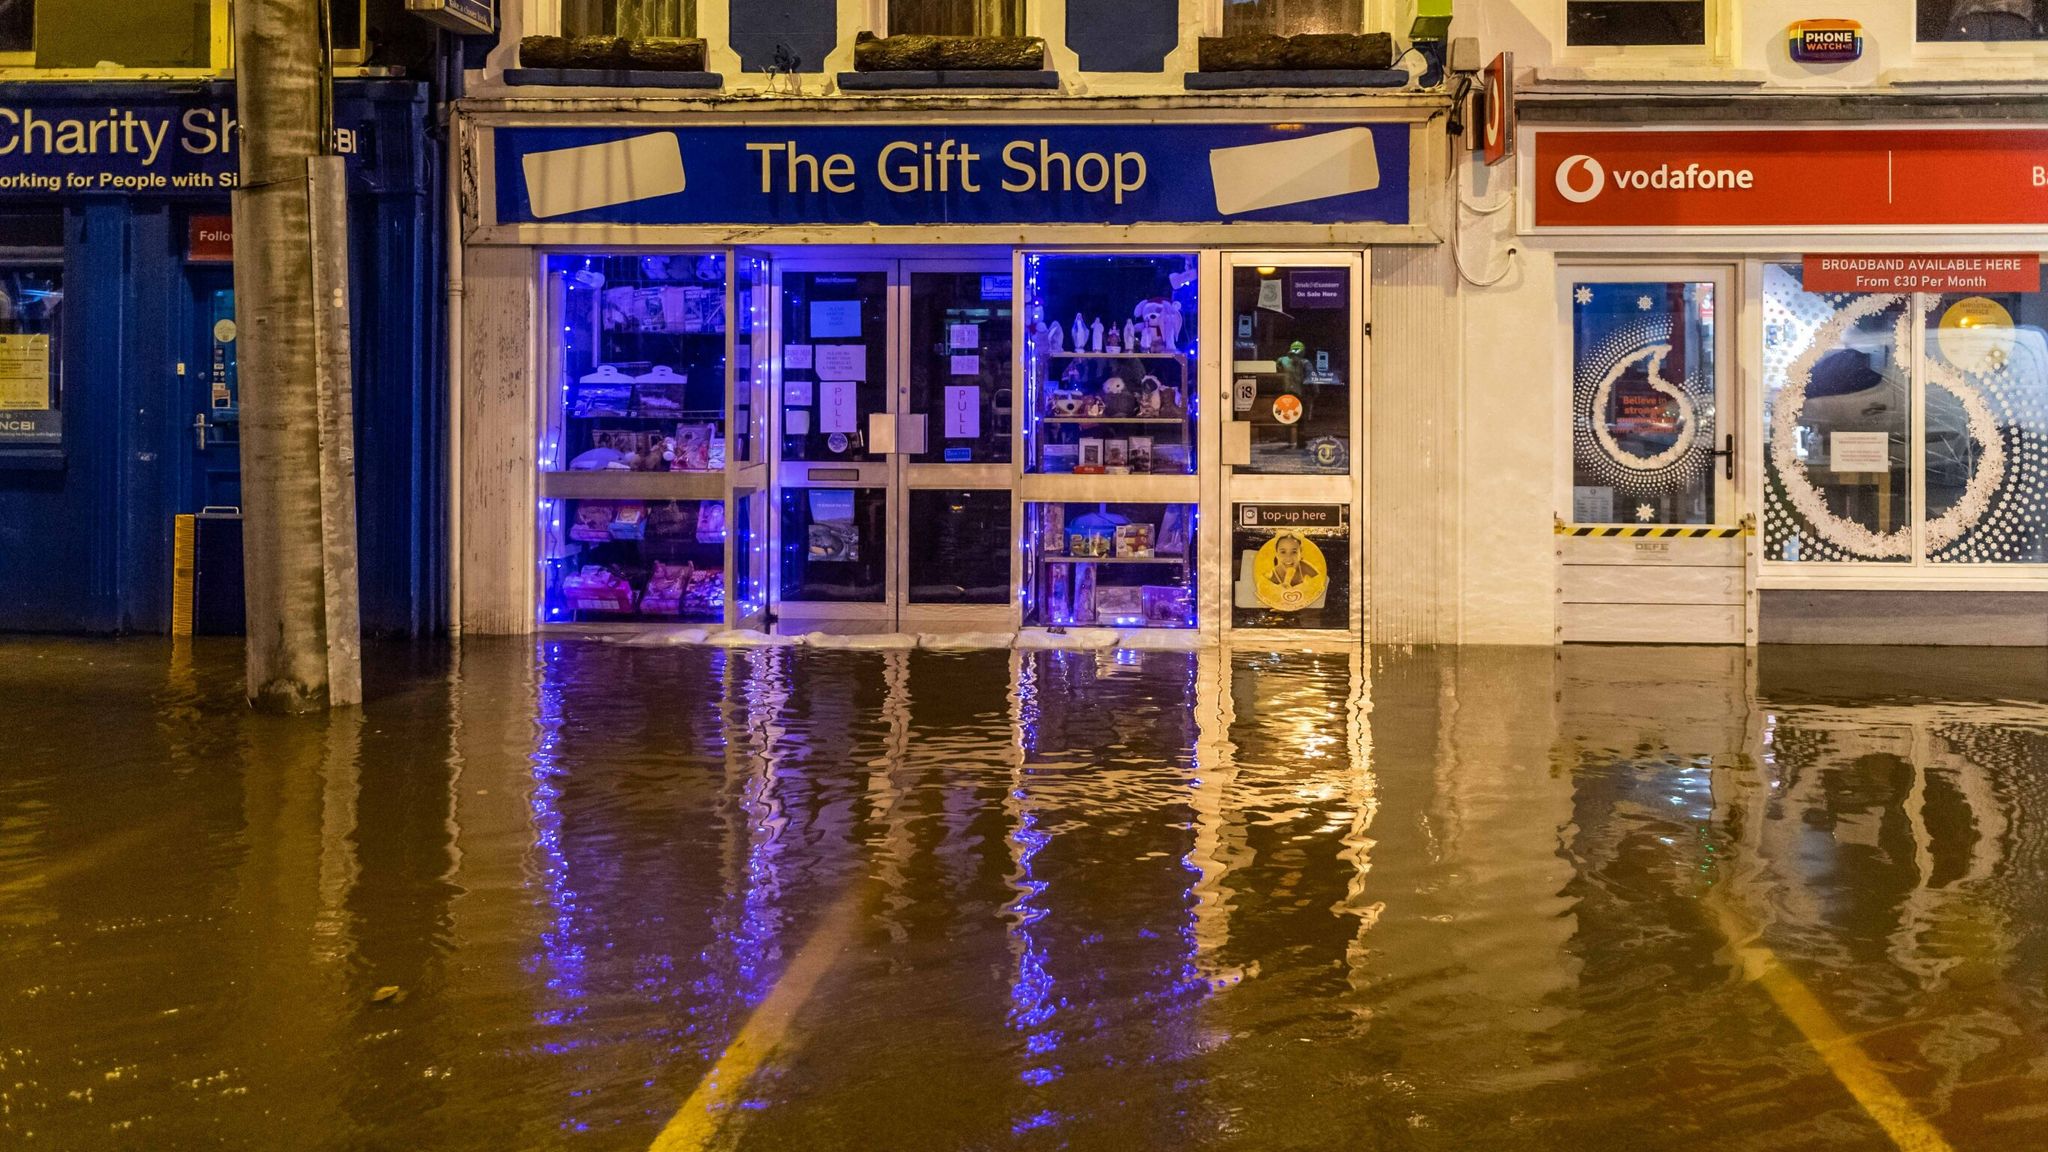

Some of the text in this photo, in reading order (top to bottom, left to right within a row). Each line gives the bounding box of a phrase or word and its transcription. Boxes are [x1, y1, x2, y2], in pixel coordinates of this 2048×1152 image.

[1806, 33, 1853, 42] PHONE
[0, 108, 169, 165] Charity
[333, 128, 357, 154] BI
[67, 172, 93, 188] for
[100, 172, 167, 190] People
[172, 172, 213, 187] with
[746, 139, 1147, 204] The Gift Shop
[1613, 164, 1754, 189] vodafone
[2033, 166, 2048, 186] B
[1822, 259, 2021, 270] BROADBAND AVAILABLE HERE
[1856, 276, 1986, 287] From €30 Per Month
[834, 388, 842, 427] PULL
[1623, 396, 1657, 405] Believe
[958, 390, 967, 434] PULL
[0, 421, 35, 430] NCBI
[1263, 510, 1327, 522] top-up here
